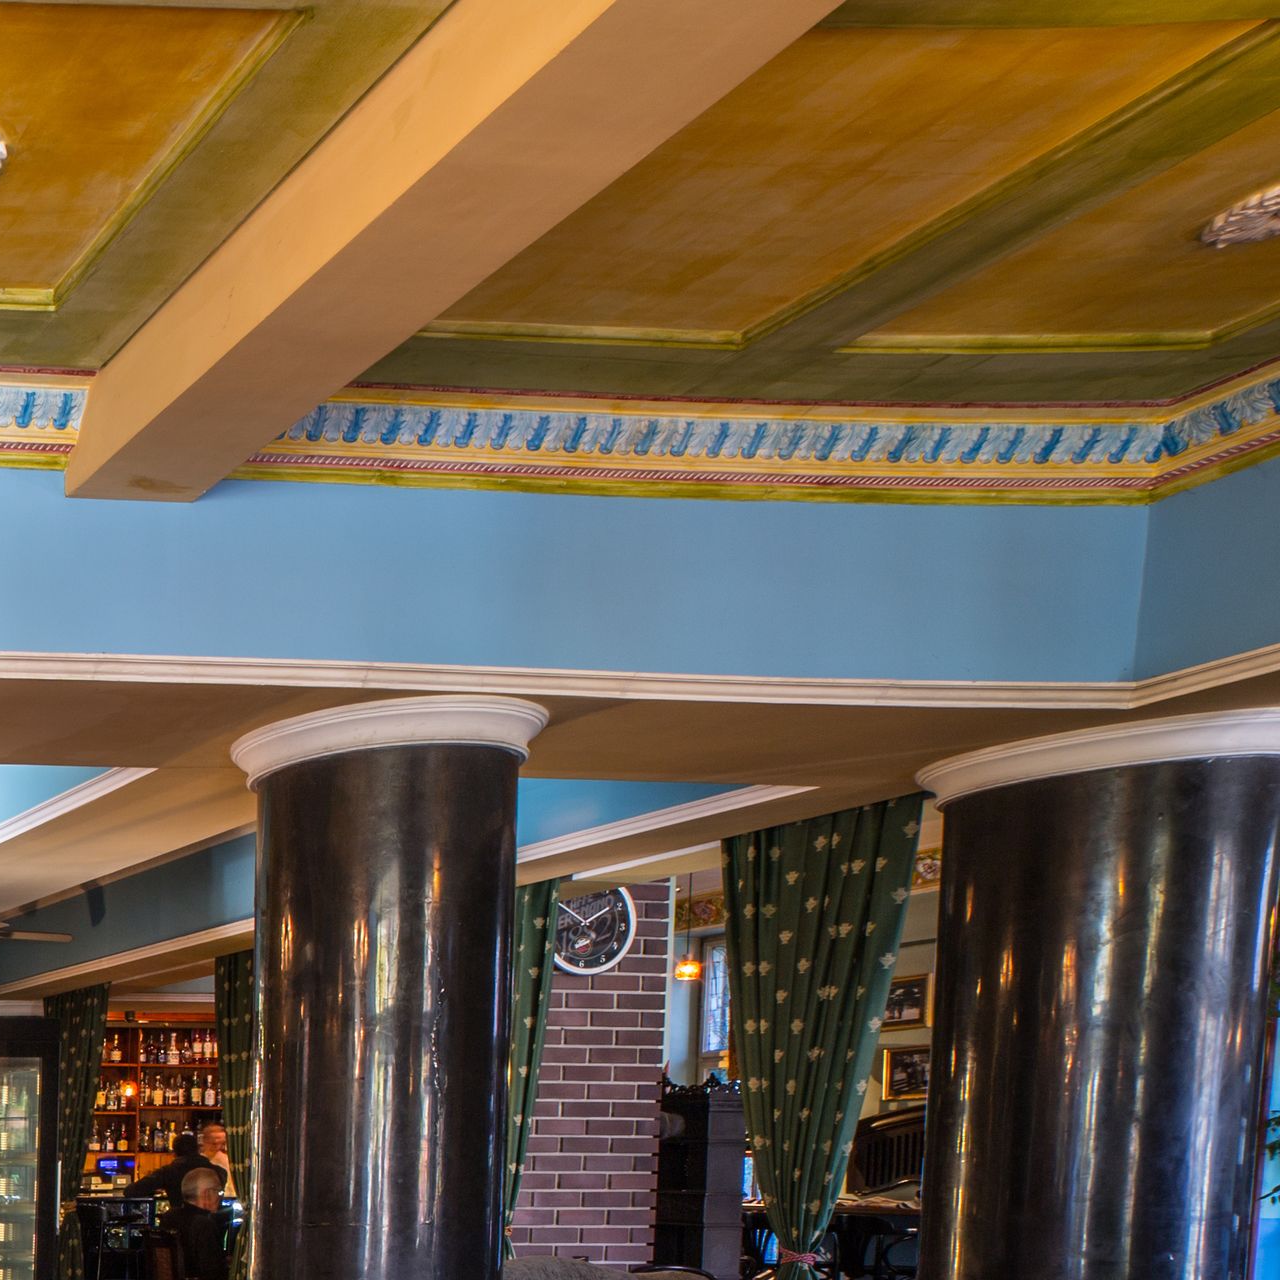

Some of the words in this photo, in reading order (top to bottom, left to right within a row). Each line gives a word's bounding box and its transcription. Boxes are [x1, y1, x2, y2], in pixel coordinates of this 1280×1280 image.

[619, 923, 626, 931] 3
[600, 955, 606, 963] 5
[579, 960, 585, 968] 6
